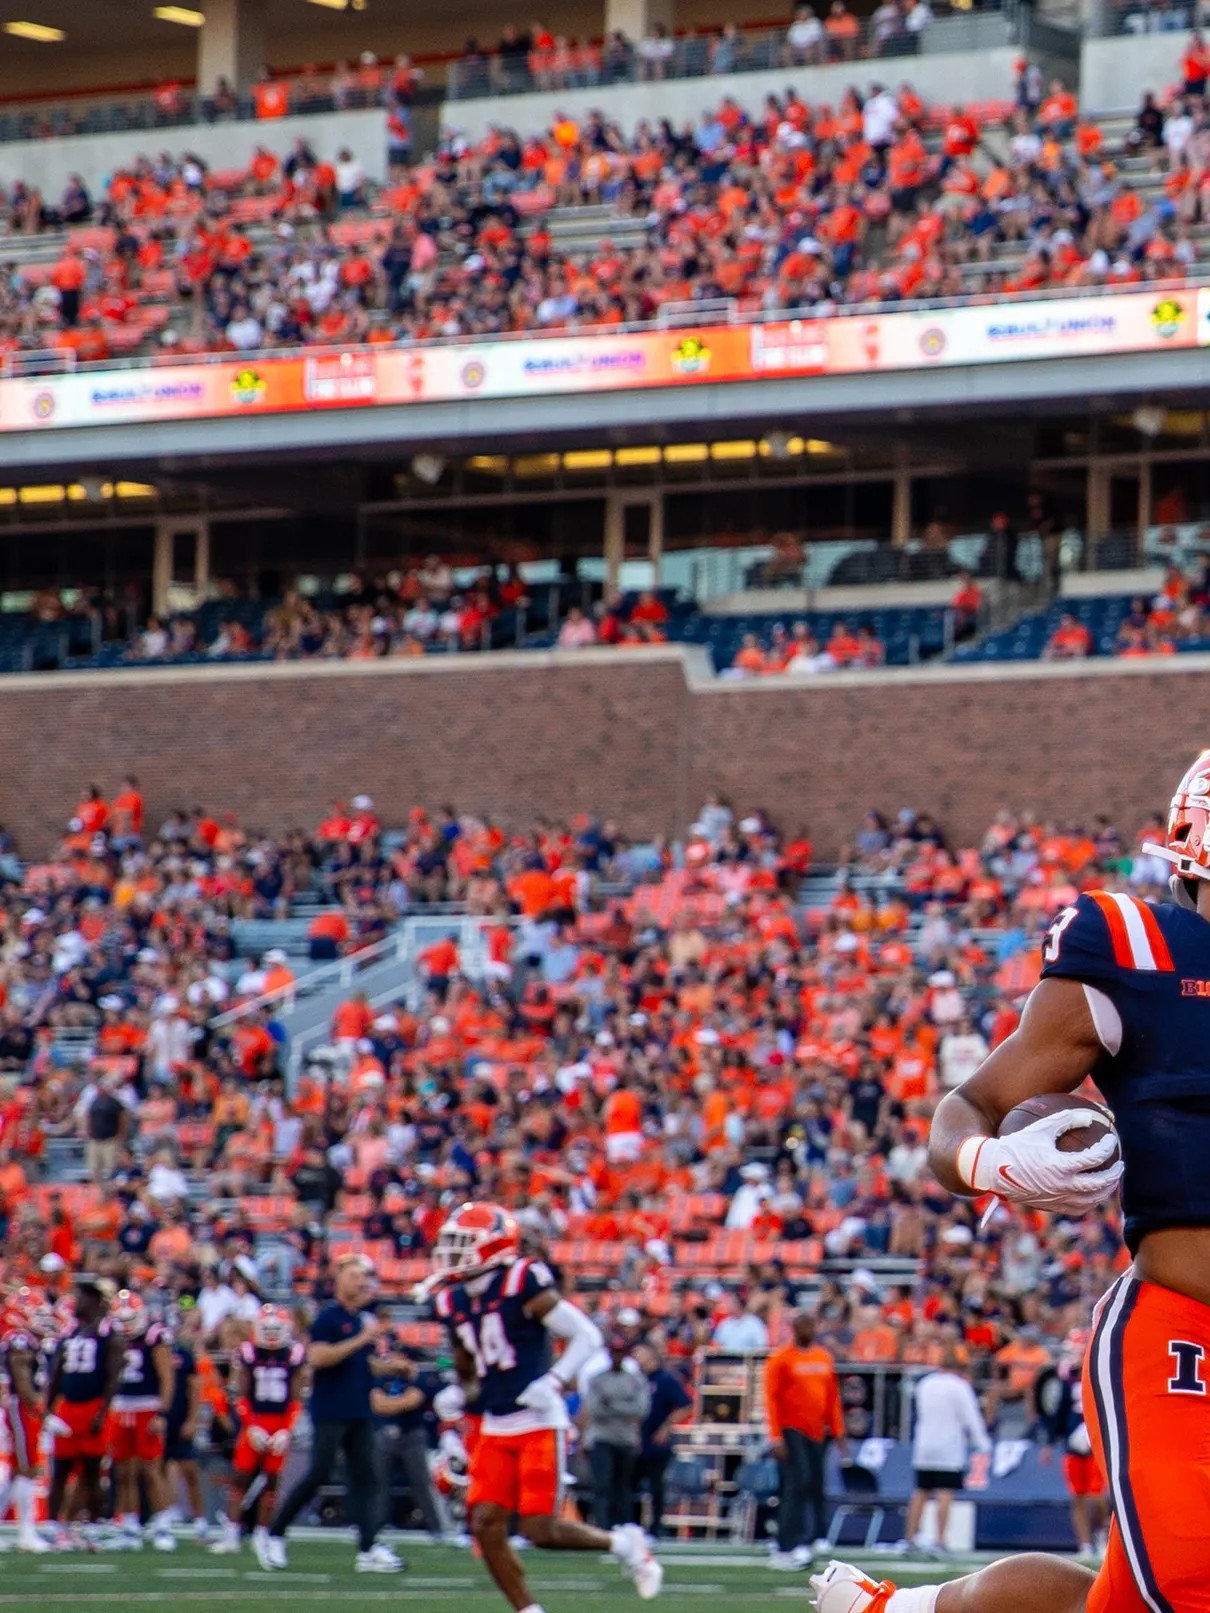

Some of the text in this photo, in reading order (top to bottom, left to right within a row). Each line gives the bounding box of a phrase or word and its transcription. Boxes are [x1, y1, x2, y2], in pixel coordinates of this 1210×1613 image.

[1044, 906, 1080, 963] 3
[455, 1311, 517, 1378] 14
[1167, 1340, 1206, 1395] I
